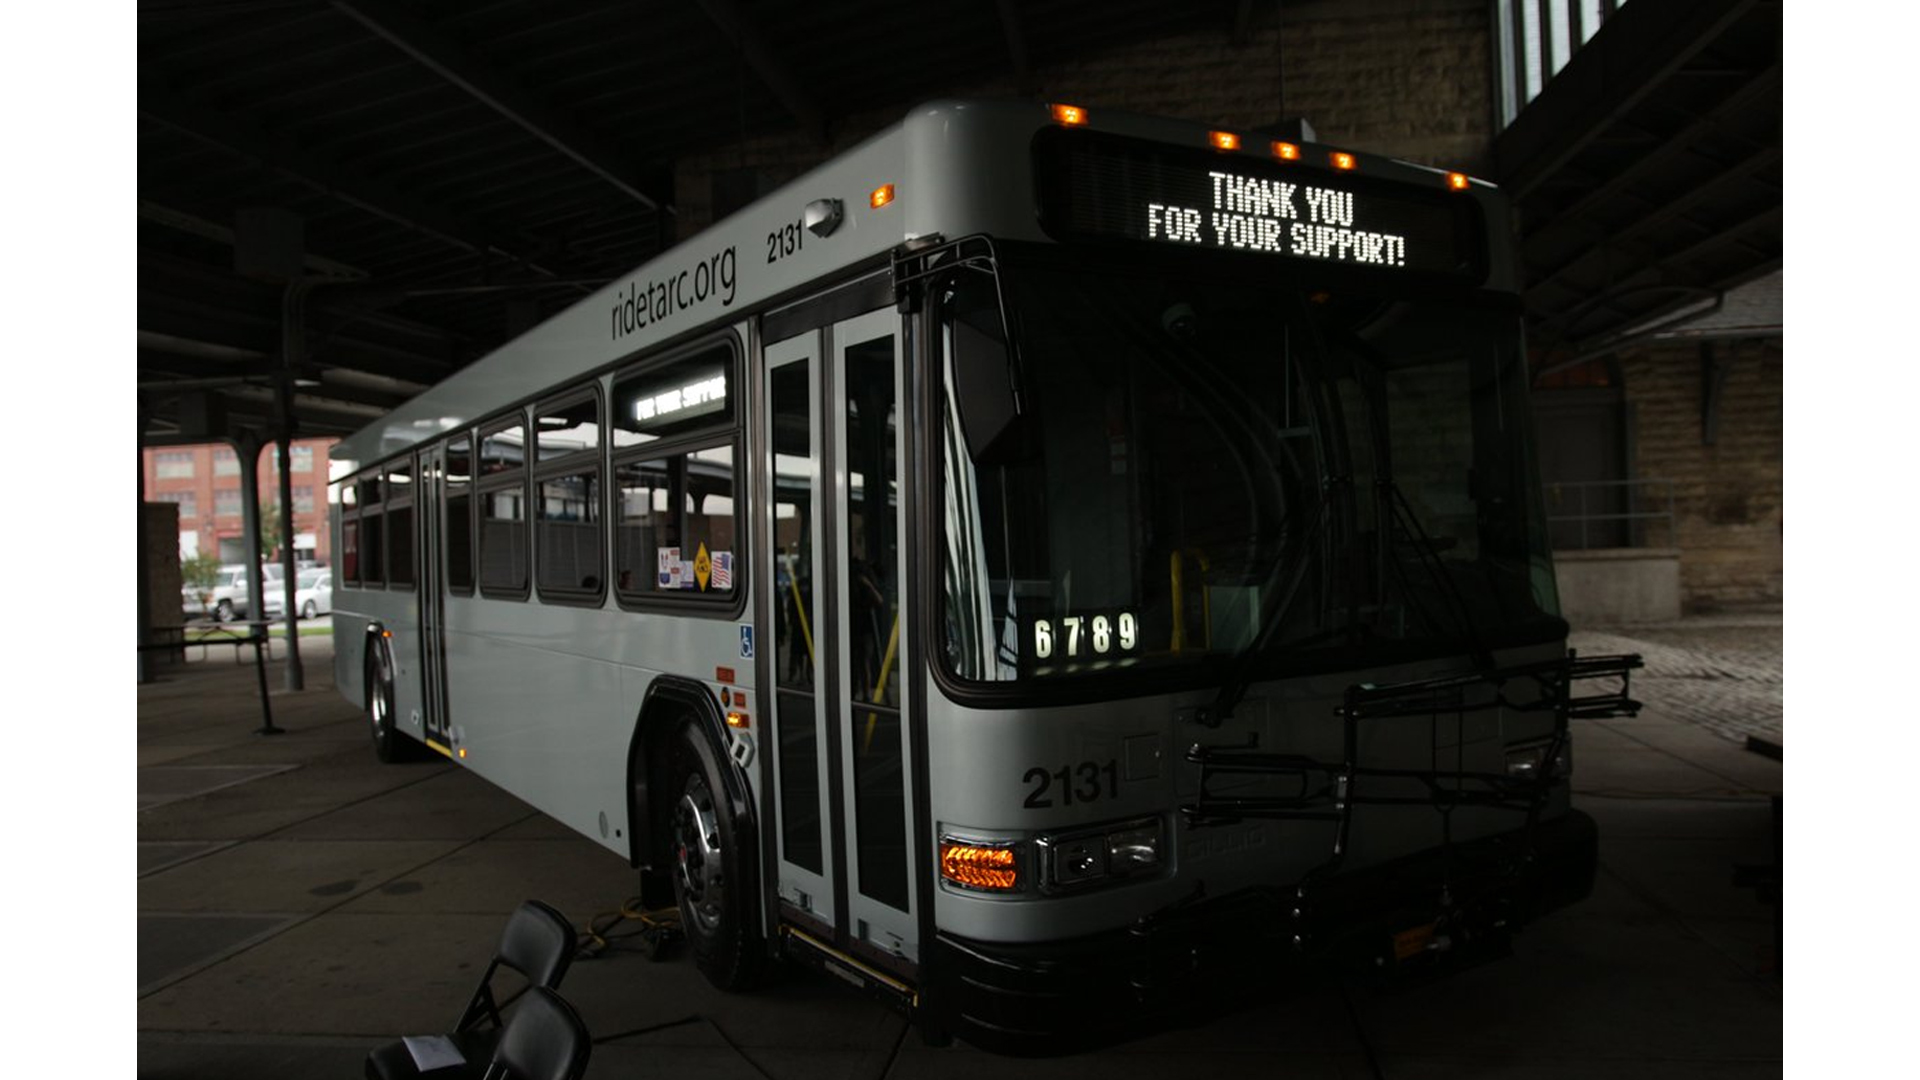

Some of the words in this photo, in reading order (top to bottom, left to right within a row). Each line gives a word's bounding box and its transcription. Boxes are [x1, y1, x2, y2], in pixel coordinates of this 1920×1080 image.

[1209, 171, 1297, 219] THANK
[1306, 186, 1353, 226] YOU
[767, 219, 802, 264] 2131
[1149, 204, 1201, 242] FOR
[1212, 212, 1281, 252] YOUR
[1291, 223, 1404, 266] SUPPORT!
[612, 245, 737, 340] ridetarc.org
[1022, 759, 1118, 808] 2131
